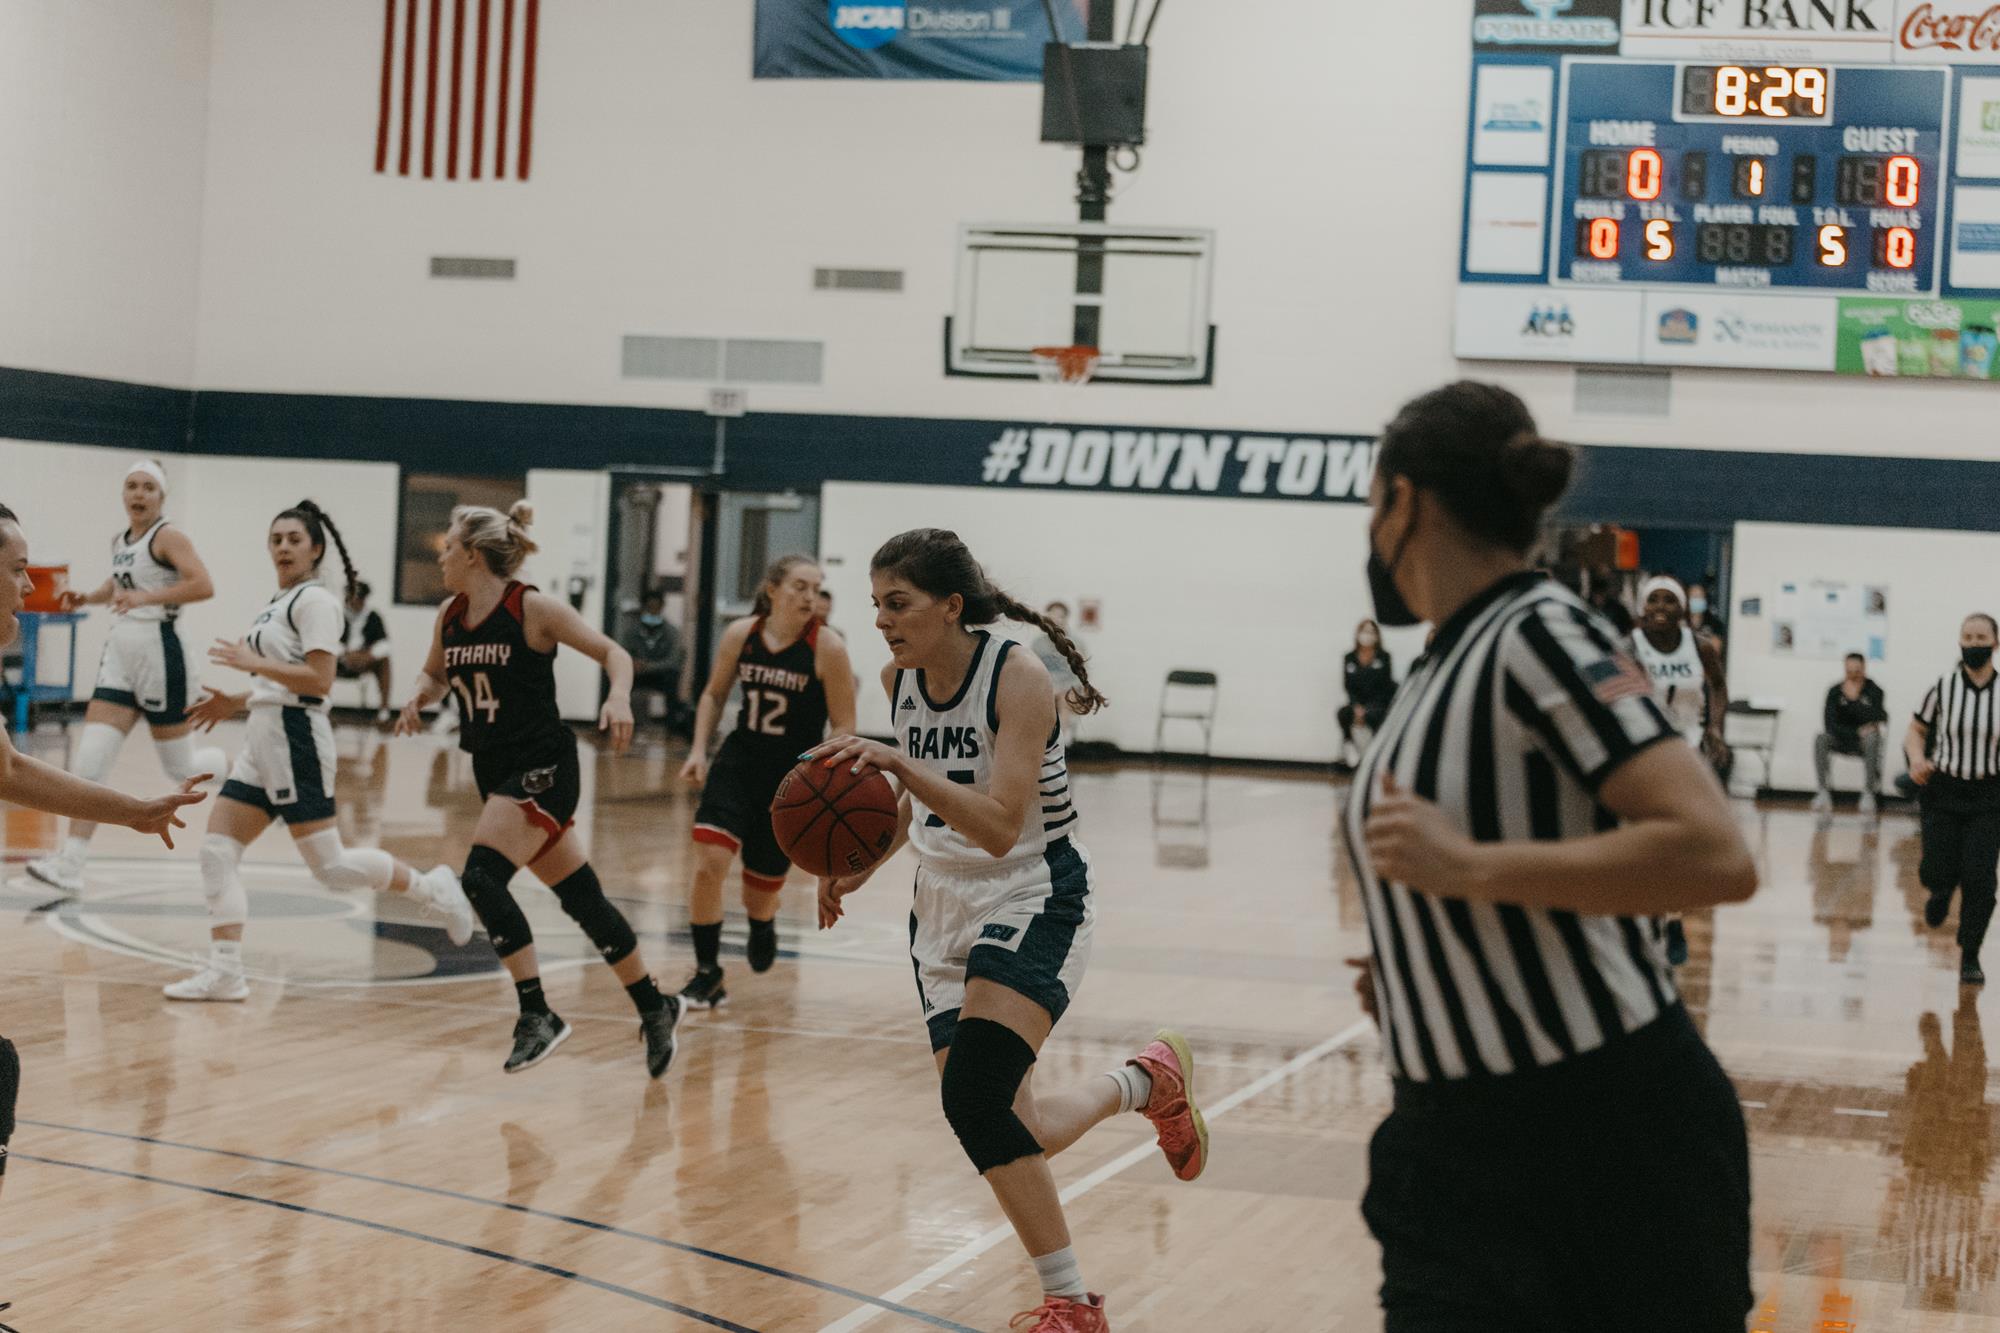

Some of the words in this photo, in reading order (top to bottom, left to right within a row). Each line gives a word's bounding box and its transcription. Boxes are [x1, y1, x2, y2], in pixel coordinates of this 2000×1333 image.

[834, 6, 904, 29] NCAA
[908, 8, 991, 30] Division
[1740, 0, 1879, 31] BANK
[1479, 21, 1612, 40] POWERADE
[1715, 66, 1825, 117] 8:29
[1589, 121, 1656, 146] HOME
[1722, 135, 1779, 156] PERIOD
[1843, 126, 1919, 153] GUEST
[1627, 147, 1662, 200] 0
[1749, 159, 1764, 196] 1
[1886, 155, 1920, 207] 0
[1573, 199, 1625, 220] FOULS
[1694, 203, 1754, 224] PLAYER
[1758, 205, 1799, 226] FOUL
[1869, 208, 1921, 229] FOULS
[1590, 217, 1619, 260] 0
[1886, 226, 1914, 268] 0
[1570, 261, 1622, 281] SCORE
[1714, 266, 1771, 287] MATCH
[1866, 271, 1919, 292] SCORE
[982, 428, 1378, 498] #DOWNTOW
[444, 643, 512, 668] ETHANY
[451, 672, 500, 723] 14
[747, 689, 788, 735] 12
[908, 726, 980, 760] RAMS
